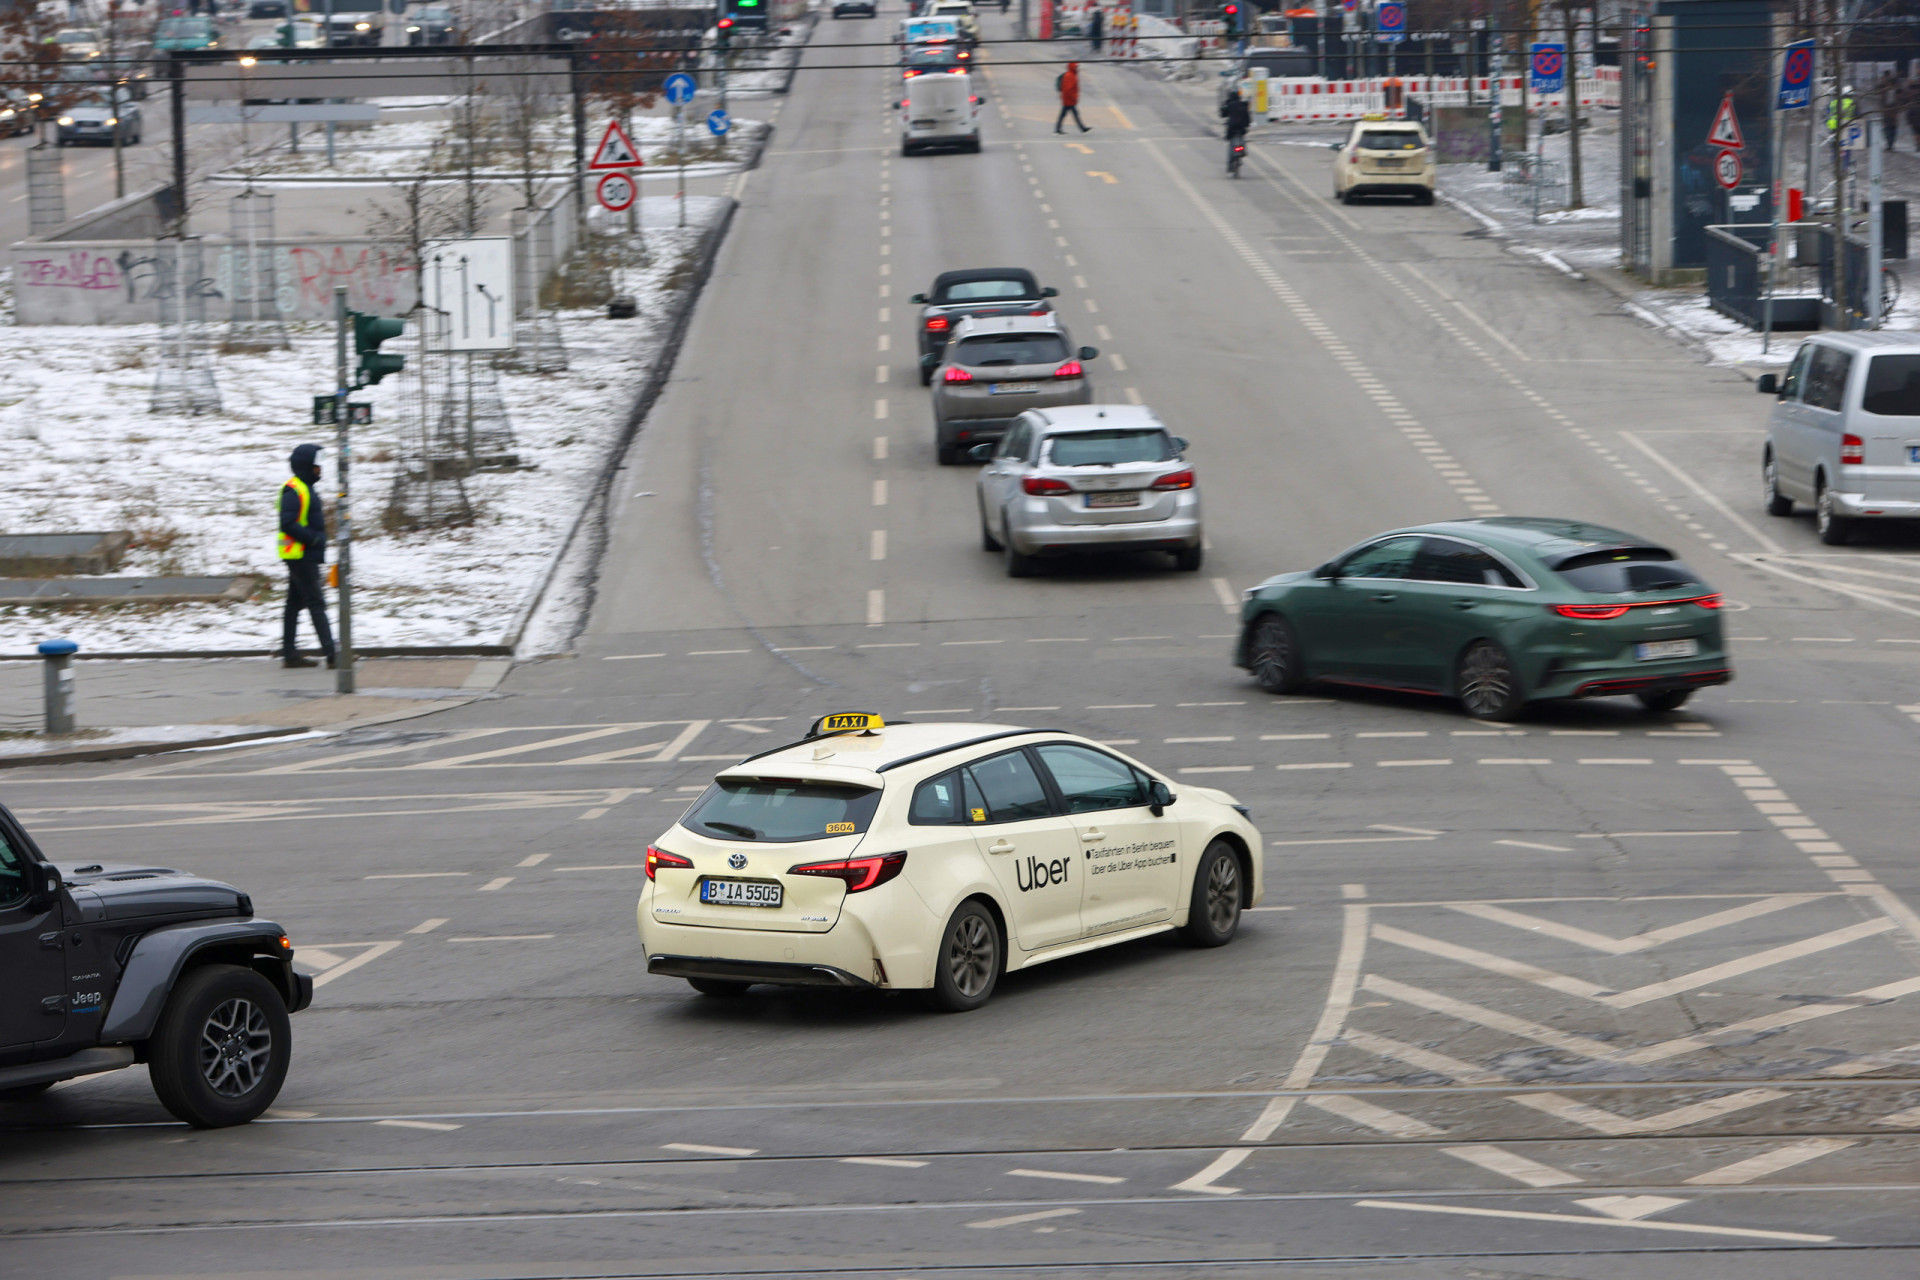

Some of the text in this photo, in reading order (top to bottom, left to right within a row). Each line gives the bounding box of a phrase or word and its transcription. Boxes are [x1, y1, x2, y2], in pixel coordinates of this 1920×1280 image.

[603, 183, 629, 201] 30
[833, 716, 864, 728] TAXI
[828, 823, 853, 833] 3604
[1091, 846, 1124, 859] Taxifahrten
[1132, 842, 1149, 854] Berlin
[1150, 839, 1176, 851] bequem
[1015, 855, 1071, 893] Uber
[1092, 855, 1171, 875] über die Uber App buchen
[709, 882, 779, 902] B IA 5505
[72, 991, 102, 1005] Jeep
